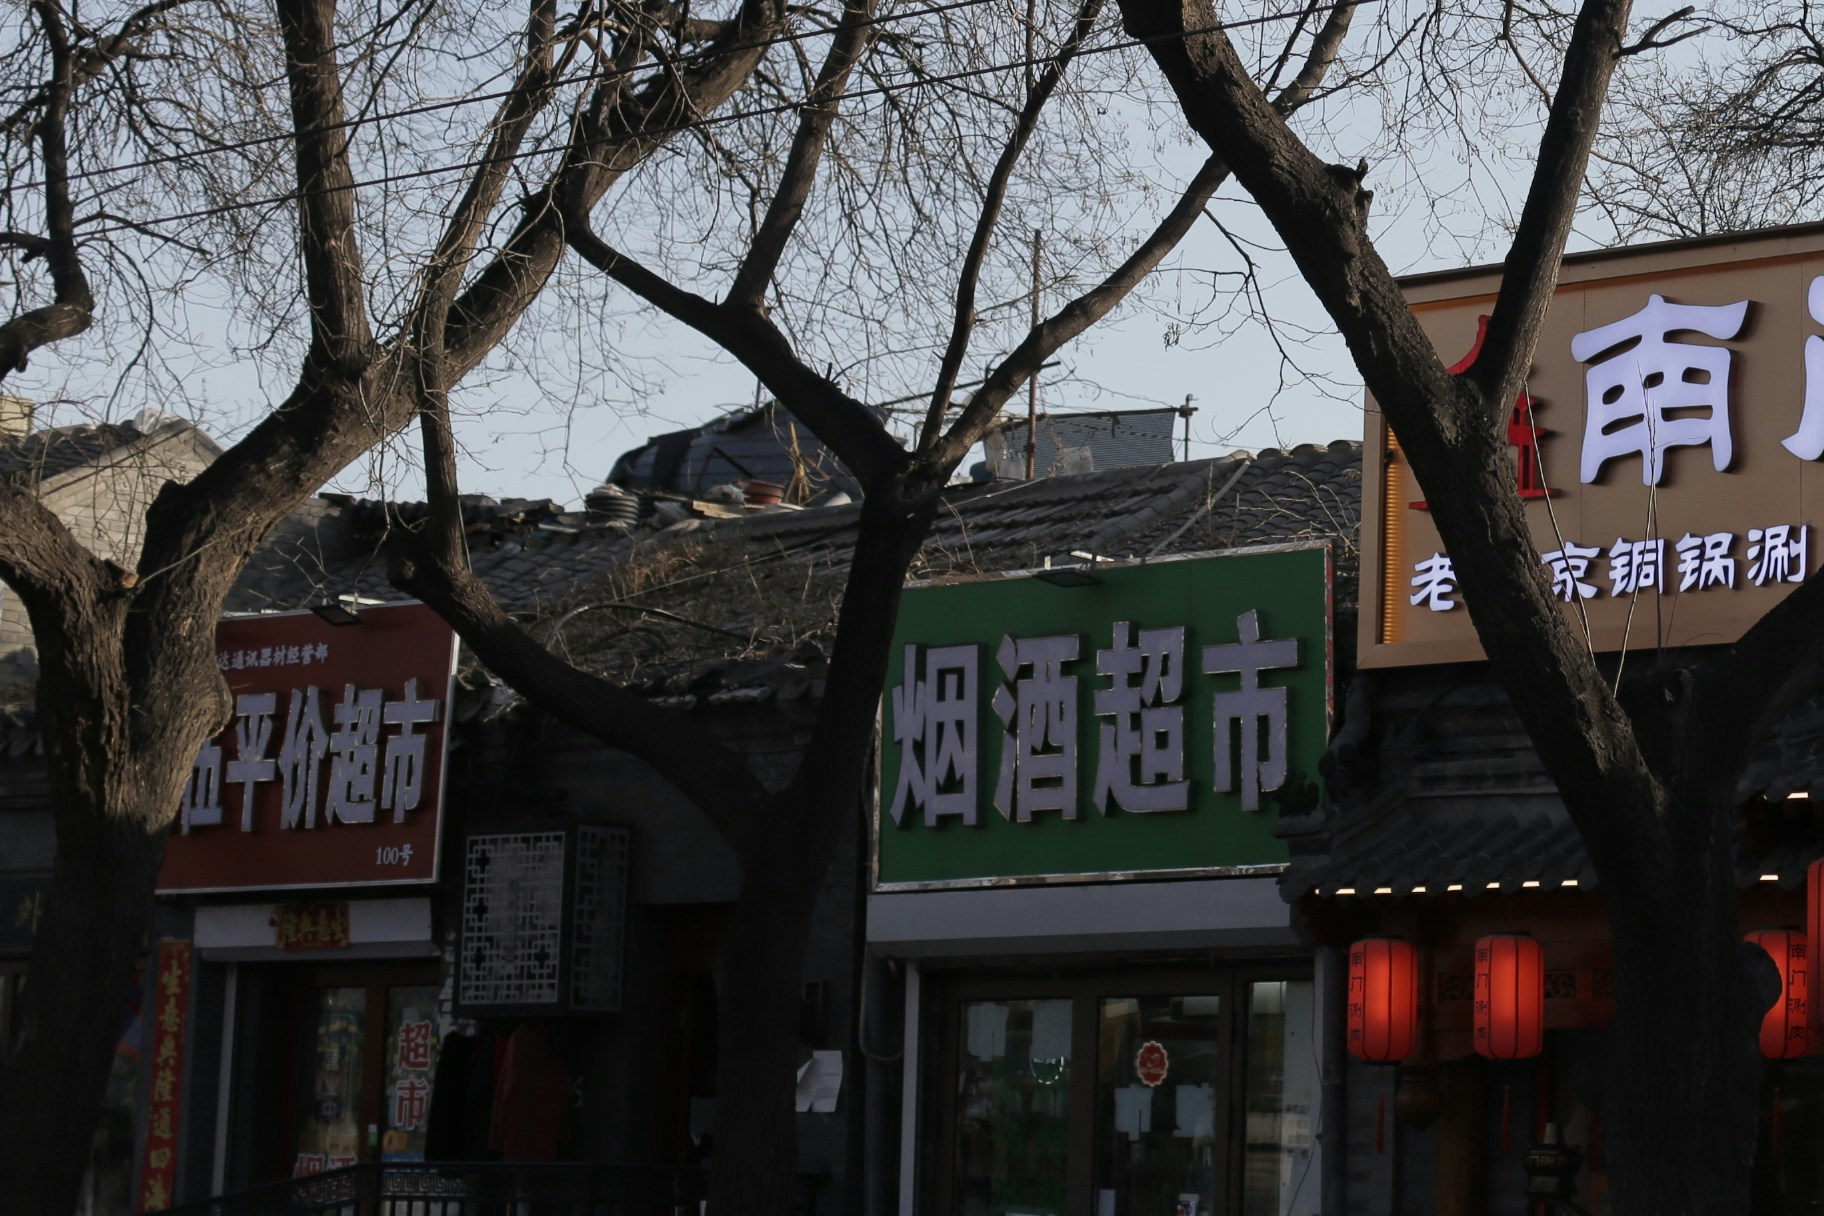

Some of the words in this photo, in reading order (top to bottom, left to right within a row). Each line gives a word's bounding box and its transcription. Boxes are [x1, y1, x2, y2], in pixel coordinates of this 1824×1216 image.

[889, 608, 1301, 828] 烟酒超市
[375, 842, 414, 867] 100号
[397, 1019, 433, 1132] 超市
